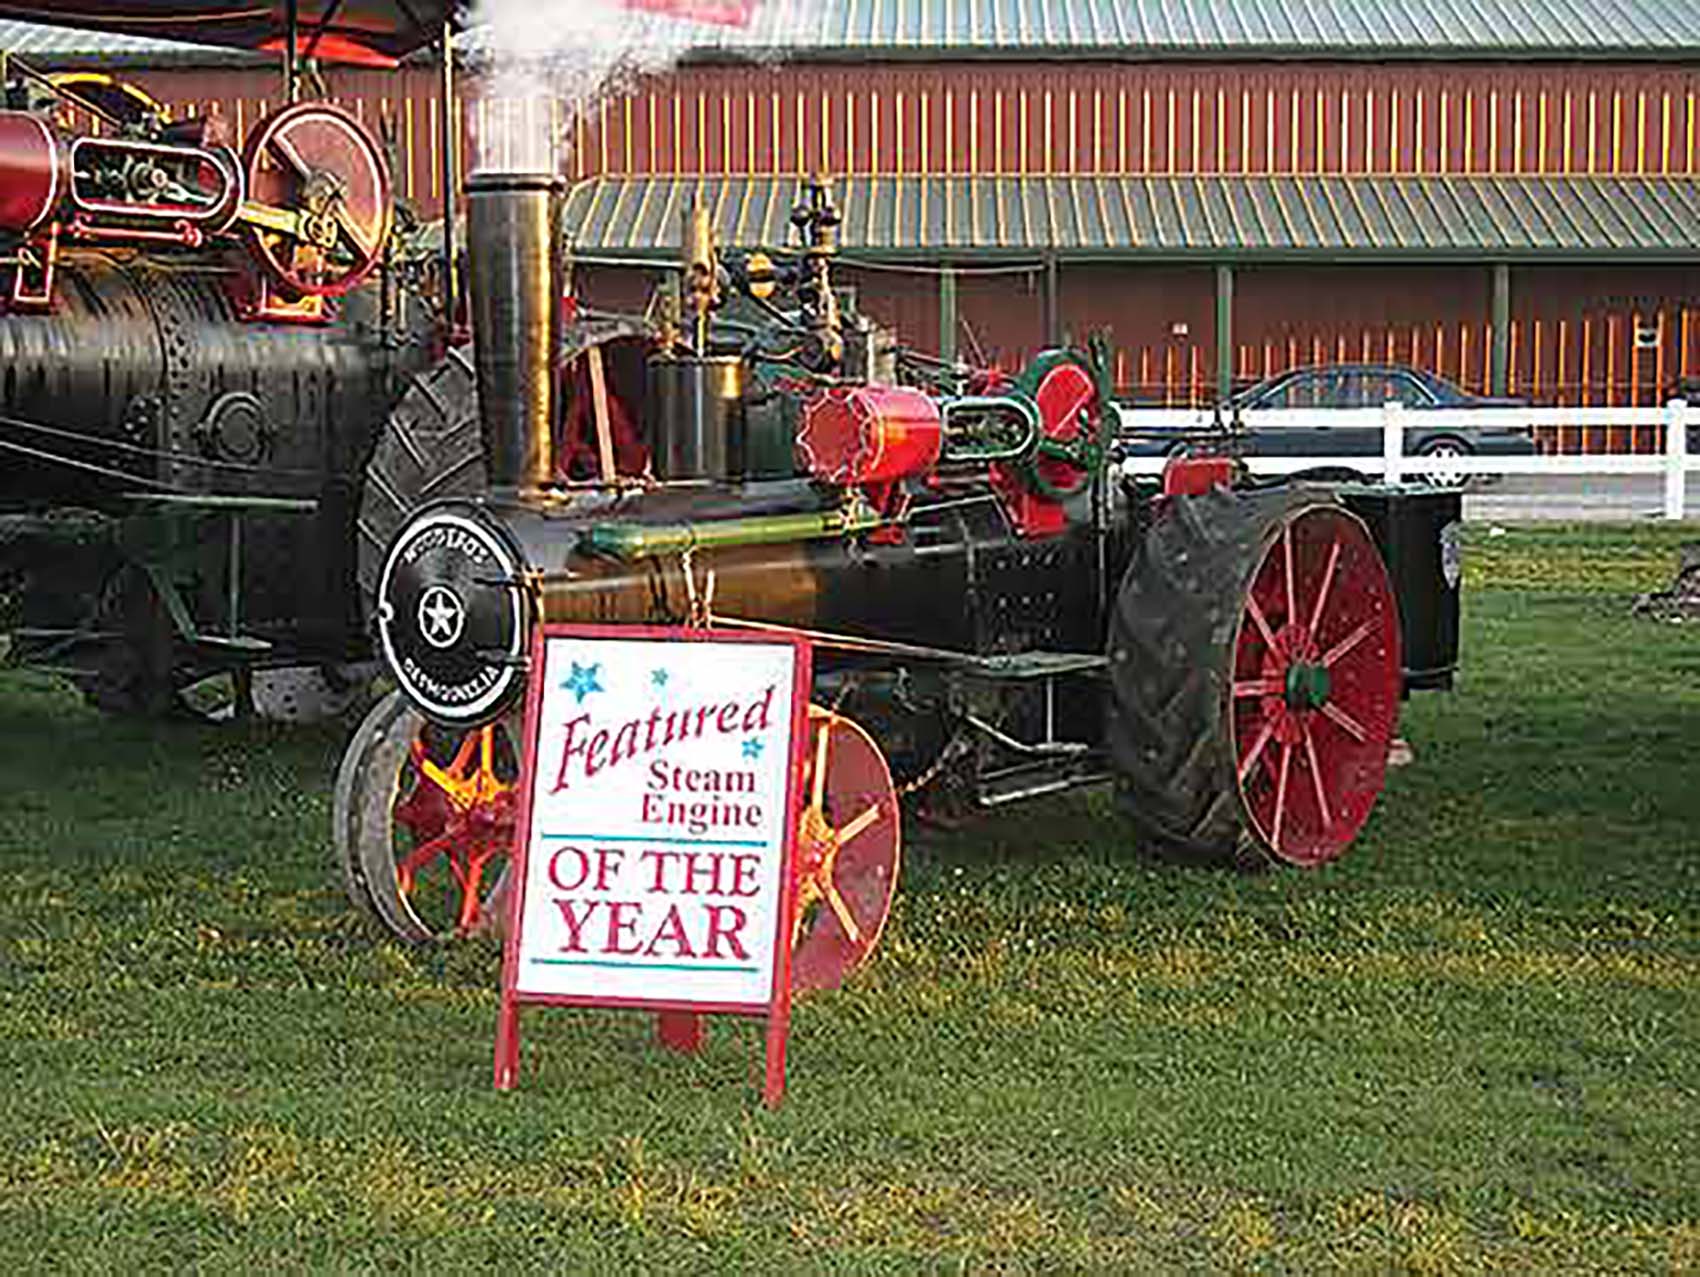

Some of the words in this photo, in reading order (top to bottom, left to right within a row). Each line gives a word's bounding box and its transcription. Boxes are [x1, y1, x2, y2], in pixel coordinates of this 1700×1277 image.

[550, 684, 776, 795] Featured
[647, 759, 756, 793] Steam
[641, 795, 763, 834] Engine
[547, 846, 626, 892] OF
[639, 851, 762, 898] THE
[552, 898, 752, 961] YEAR
